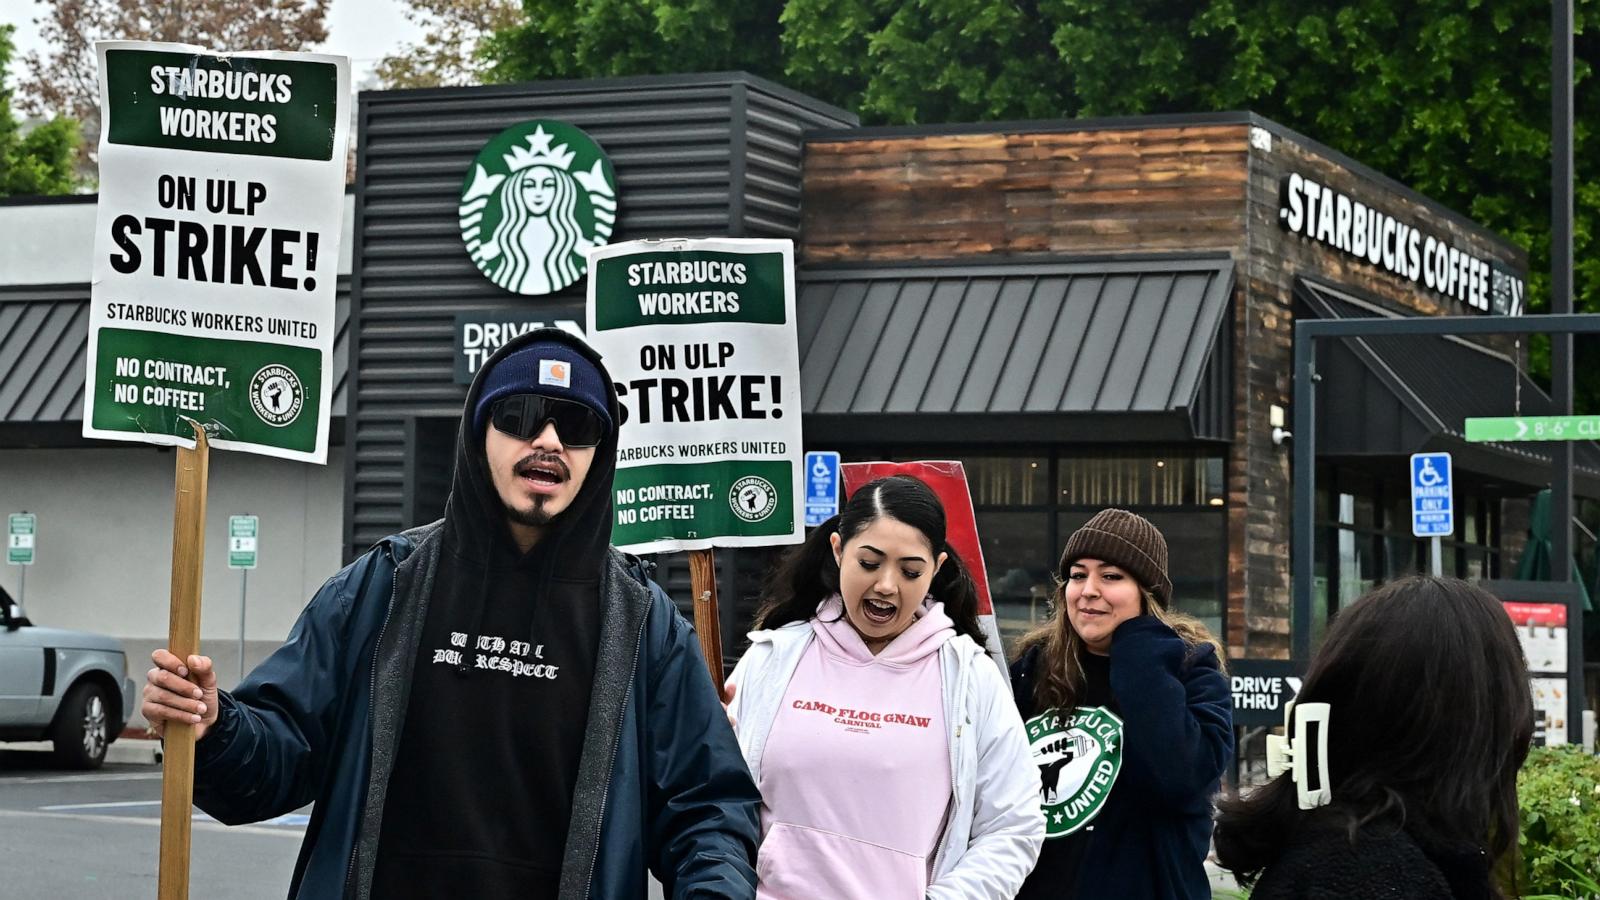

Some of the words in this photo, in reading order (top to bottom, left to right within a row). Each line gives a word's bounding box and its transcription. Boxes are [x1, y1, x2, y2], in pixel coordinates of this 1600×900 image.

[150, 65, 292, 103] STARBUCKS
[160, 106, 276, 143] WORKERS
[158, 174, 196, 211] ON
[206, 178, 267, 216] ULP
[110, 214, 319, 291] STRIKE!
[1280, 172, 1421, 282] STARBUCKS
[1423, 235, 1489, 312] COFFEE
[627, 260, 747, 287] STARBUCKS
[638, 291, 740, 316] WORKERS
[107, 302, 187, 327] STARBUCKS
[191, 311, 263, 333] WORKERS
[268, 318, 317, 339] UNITED
[463, 321, 545, 348] DRIV
[640, 344, 676, 371] ON
[684, 342, 735, 370] ULP
[116, 357, 140, 377] NO
[144, 359, 231, 389] CONTRACT,
[257, 368, 298, 388] STARBUCKS
[114, 383, 138, 404] NO
[143, 386, 205, 411] COFFEE!
[252, 391, 276, 422] WORKERS
[281, 397, 301, 421] UNITED
[616, 444, 675, 462] ARBUCKS
[678, 441, 738, 458] WORKERS
[741, 441, 786, 455] UNITED
[616, 488, 636, 505] NO
[638, 484, 713, 502] CONTRACT,
[735, 478, 771, 492] STARBUCKS
[617, 507, 637, 525] NO
[639, 504, 694, 522] COFFEE!
[731, 497, 753, 519] WORKERS
[758, 497, 775, 517] UNITED
[432, 649, 463, 665] DU
[474, 654, 559, 680] RESPECT
[1231, 676, 1282, 693] DRIVE
[792, 700, 837, 716] CAMP
[838, 709, 881, 722] FLOG
[883, 713, 931, 728] GNAW
[1231, 693, 1279, 710] THRU
[834, 717, 882, 729] CARNIVAL
[1030, 713, 1117, 741] STARBUCK
[1063, 760, 1114, 820] UNITED
